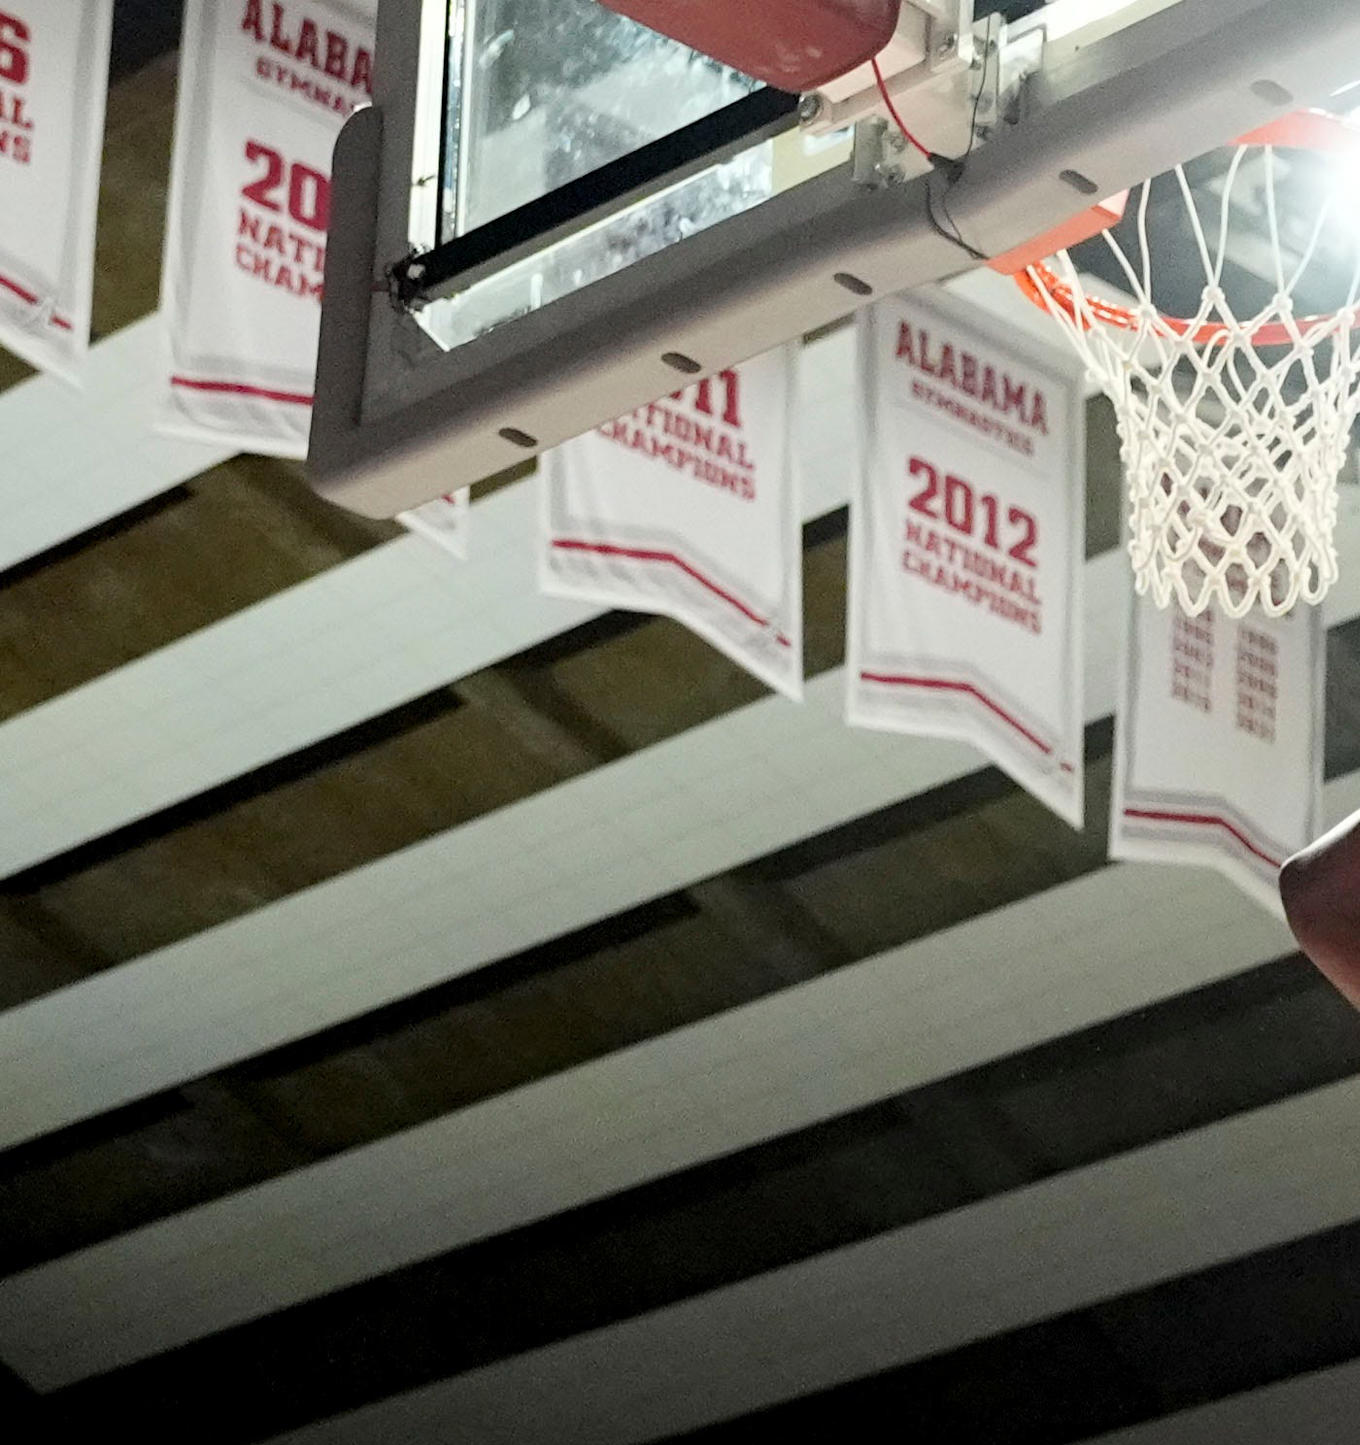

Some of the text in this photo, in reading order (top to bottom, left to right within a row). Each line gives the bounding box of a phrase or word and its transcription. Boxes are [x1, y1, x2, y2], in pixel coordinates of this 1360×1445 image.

[242, 0, 373, 96] ALABA
[242, 140, 332, 231] 20
[238, 210, 326, 272] NATI
[896, 320, 1049, 436] ALABAMA
[908, 457, 1038, 568] 2012
[903, 550, 1042, 635] CHAMPIONS
[905, 518, 1041, 606] NATIONAL
